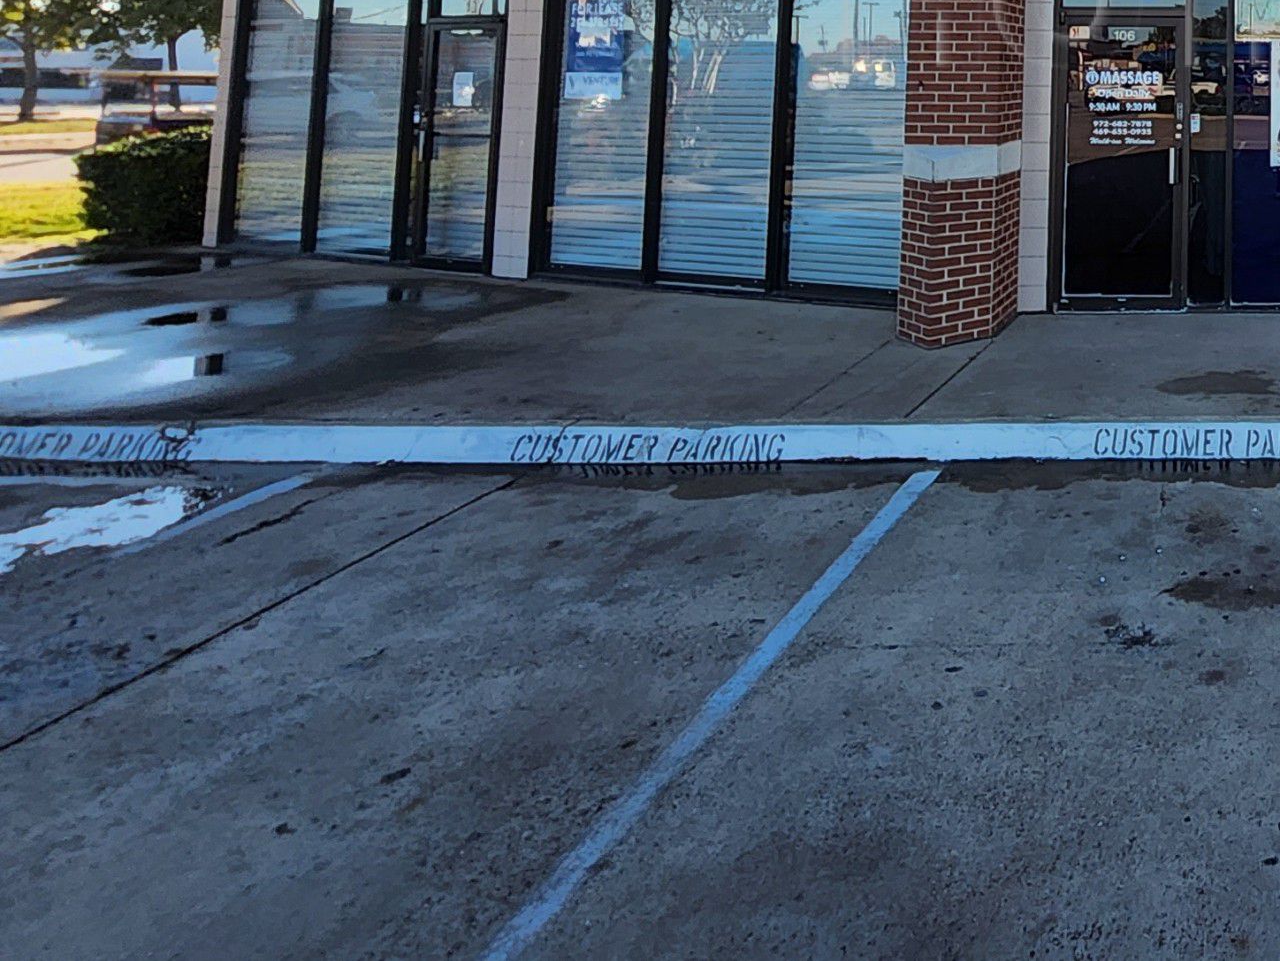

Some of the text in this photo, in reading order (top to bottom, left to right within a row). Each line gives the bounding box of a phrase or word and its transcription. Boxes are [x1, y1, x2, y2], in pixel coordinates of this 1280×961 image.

[1113, 30, 1136, 42] 106
[1100, 70, 1160, 85] MASSAGE
[1098, 88, 1123, 98] Open
[510, 433, 786, 462] CUSTOMER PARKING
[1094, 428, 1233, 457] CUSTOMER
